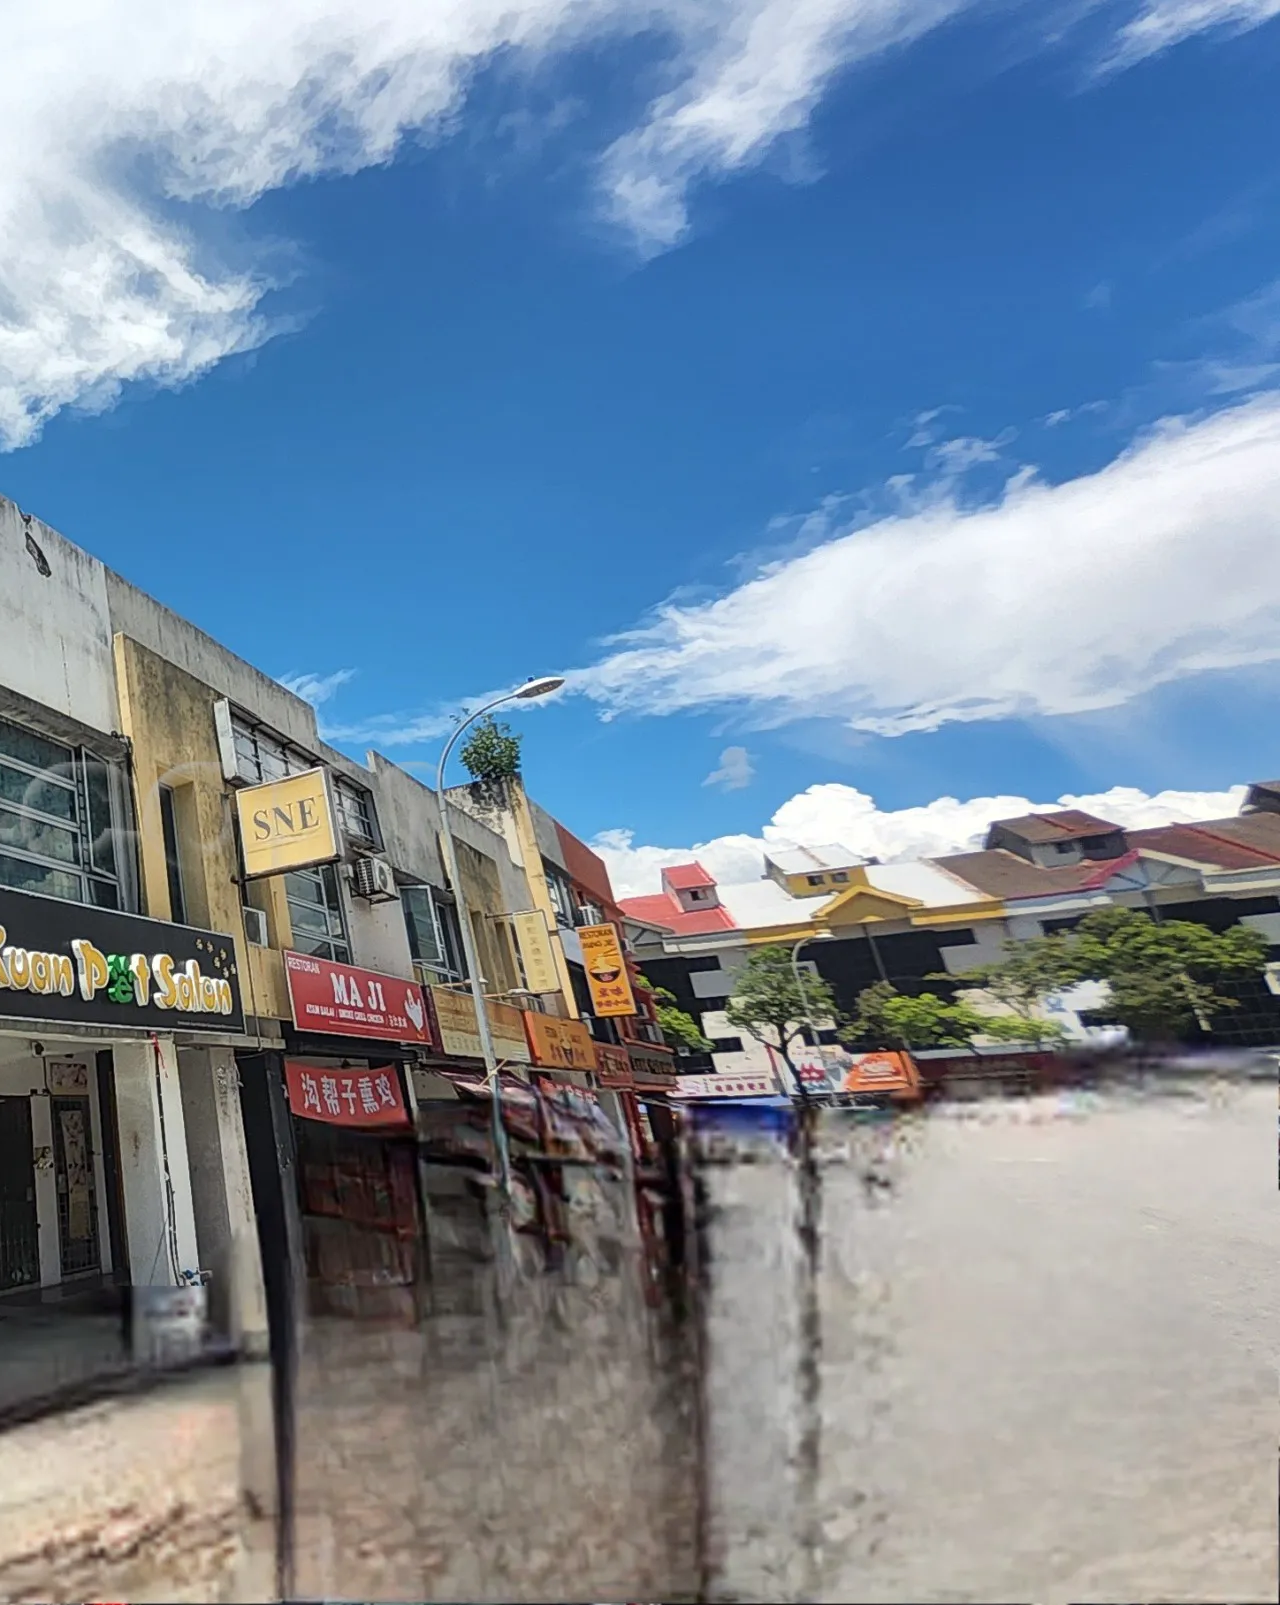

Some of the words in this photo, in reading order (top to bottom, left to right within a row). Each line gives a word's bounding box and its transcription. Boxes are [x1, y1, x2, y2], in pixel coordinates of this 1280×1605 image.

[253, 797, 320, 841] SNE
[152, 953, 233, 1015] Salon
[287, 956, 321, 975] RESTORAN
[330, 972, 365, 1008] MA
[367, 980, 387, 1012] JI
